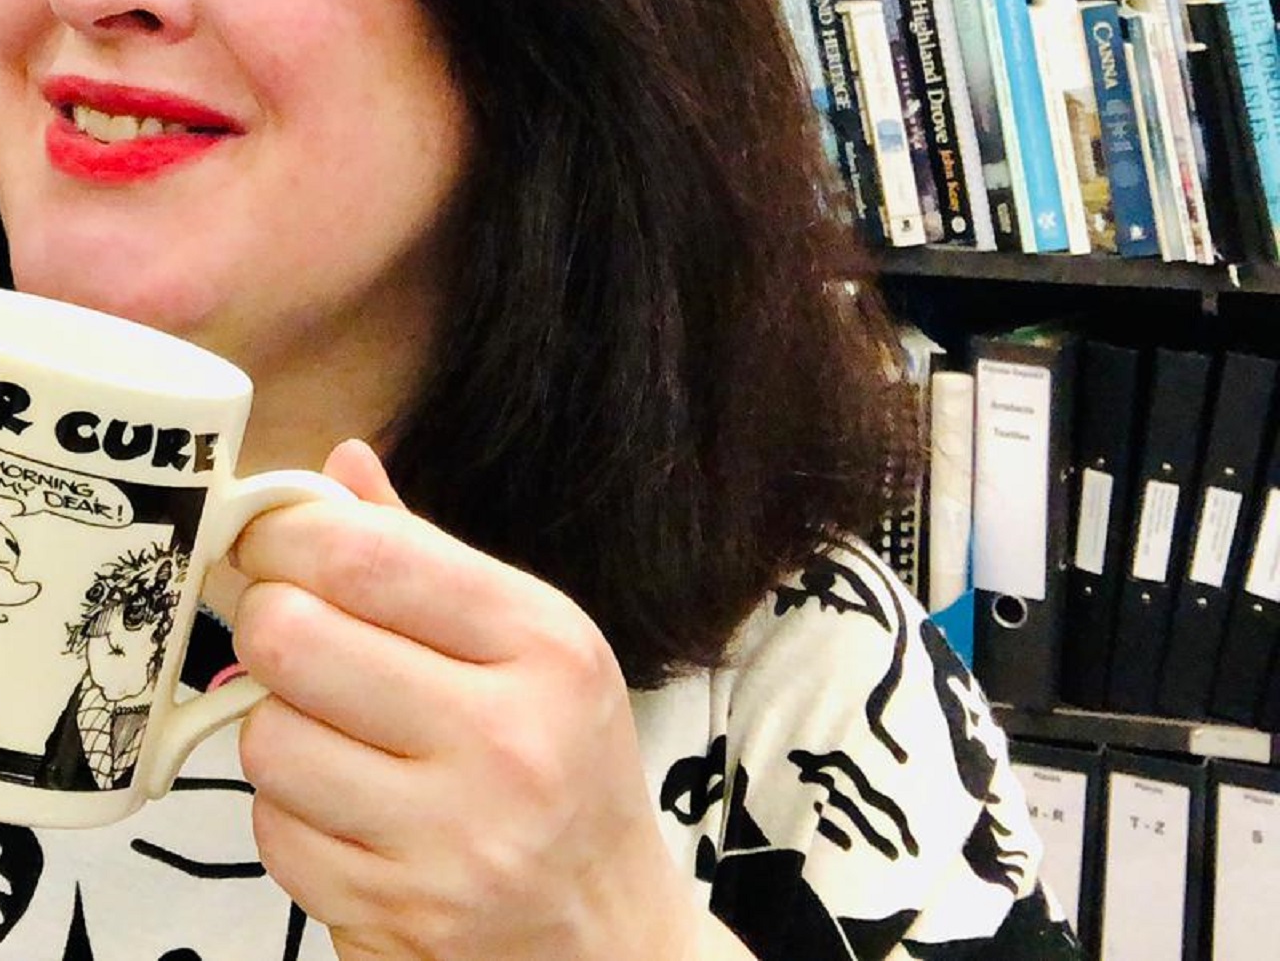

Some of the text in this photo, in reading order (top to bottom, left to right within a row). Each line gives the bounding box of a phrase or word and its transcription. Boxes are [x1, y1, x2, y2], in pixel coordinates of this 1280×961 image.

[1091, 19, 1123, 91] CANNA
[925, 87, 954, 146] Drove
[54, 409, 220, 474] CURE
[1052, 809, 1064, 822] R
[1129, 816, 1140, 829] T
[1154, 821, 1166, 835] Z
